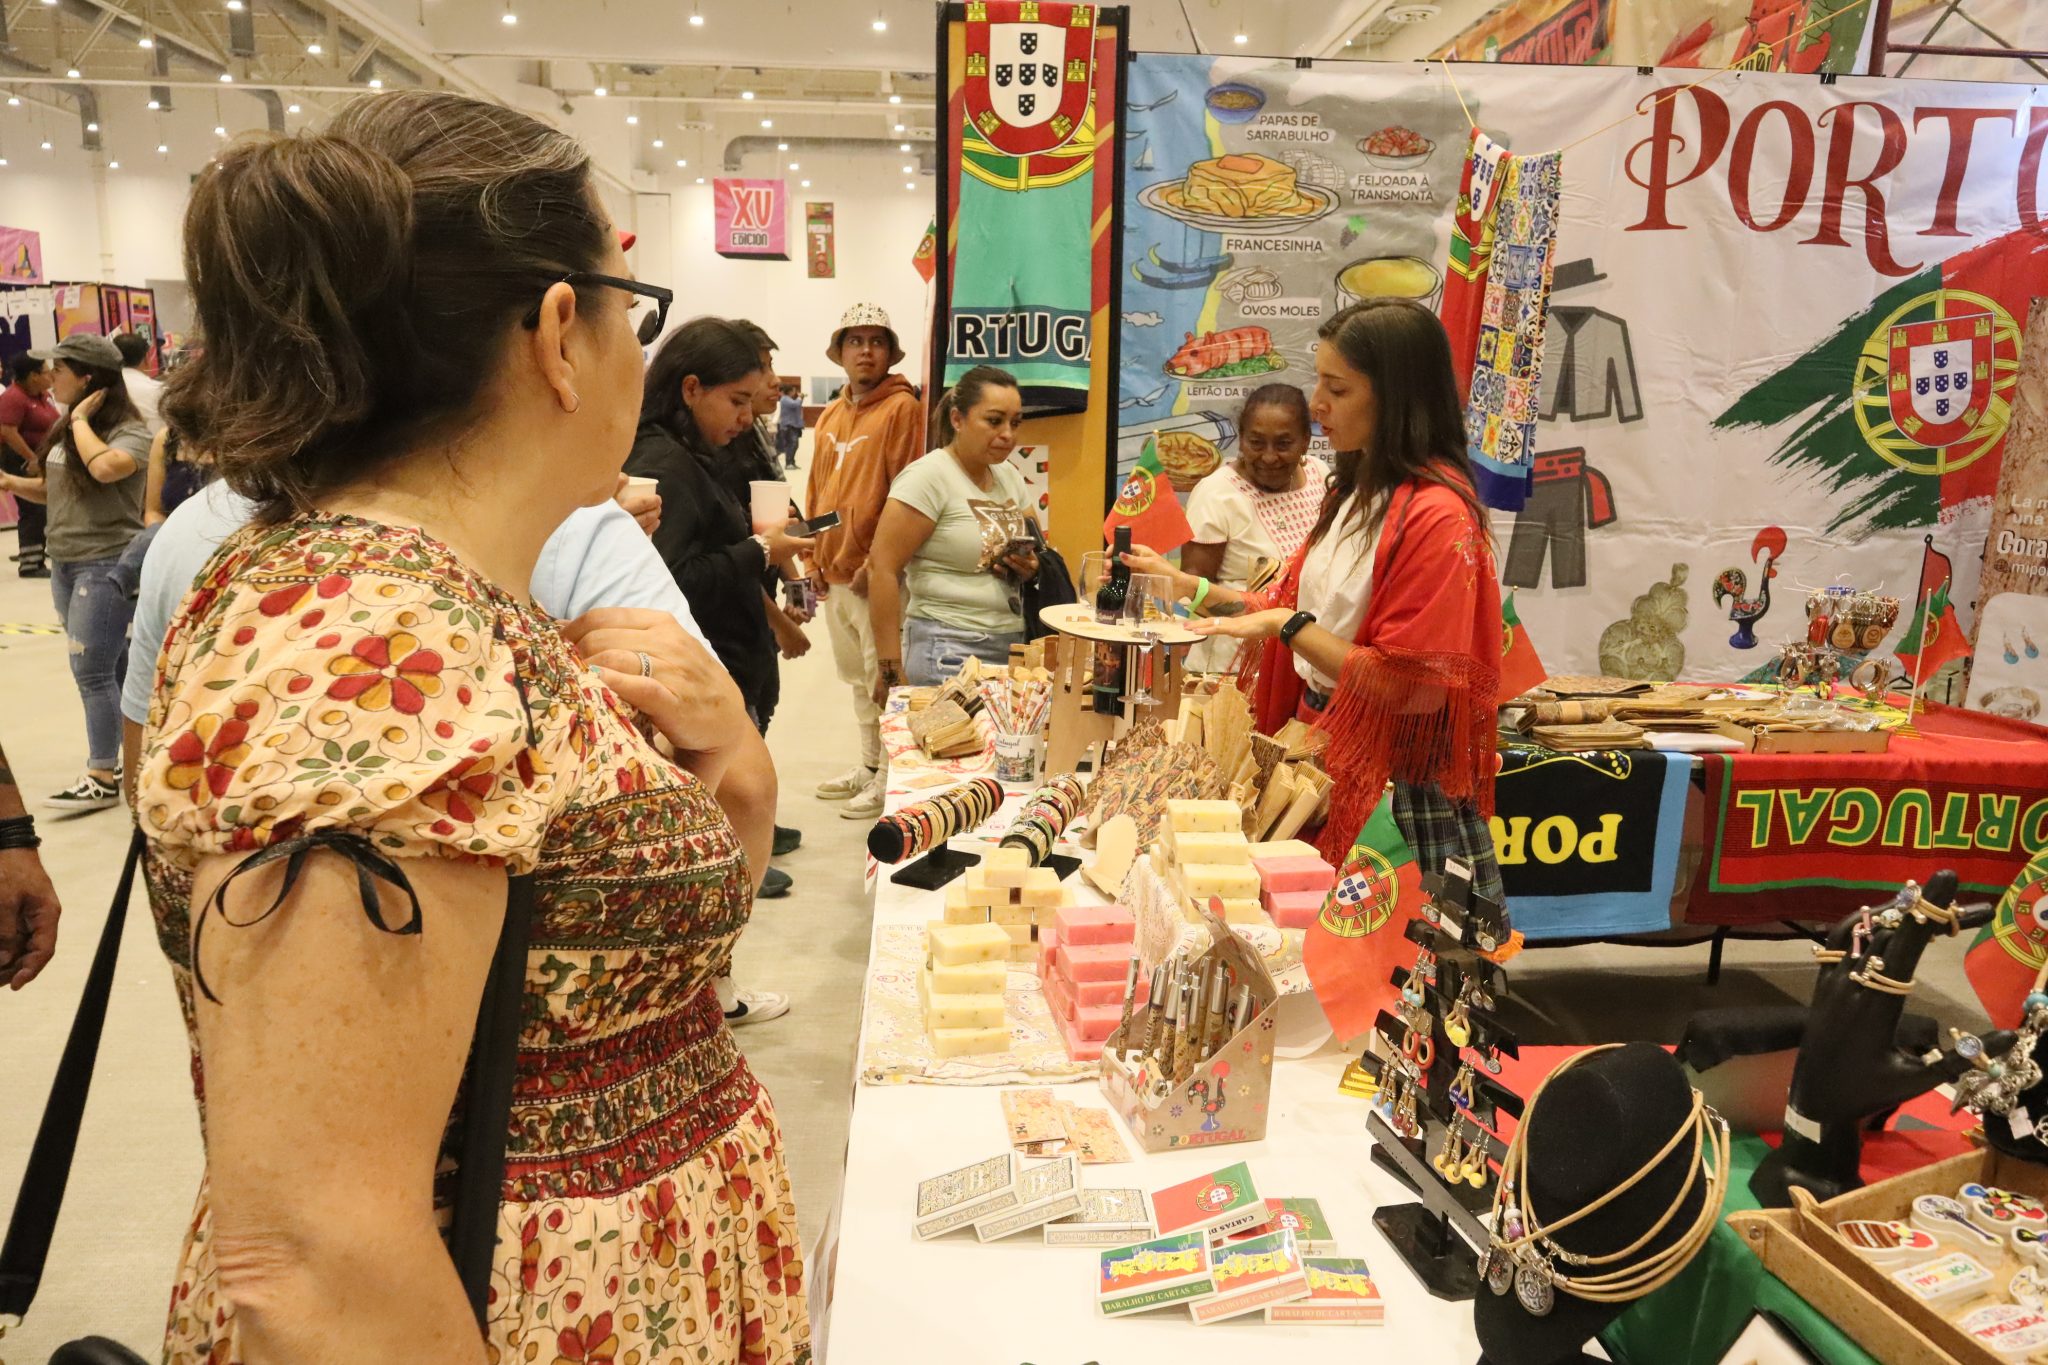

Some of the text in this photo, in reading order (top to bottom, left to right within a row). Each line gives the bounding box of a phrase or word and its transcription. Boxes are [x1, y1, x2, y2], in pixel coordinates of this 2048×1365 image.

[1259, 115, 1319, 127] PAPAS DE
[1246, 129, 1330, 143] SARRABULHO
[1357, 172, 1430, 187] FEIJOADA À
[1350, 188, 1434, 202] TRANSMONTA
[730, 187, 774, 230] XV
[1226, 238, 1323, 252] FRANCESINHA
[1241, 304, 1320, 317] OVOS MOLES
[946, 311, 1091, 362] RTUG
[1187, 385, 1222, 397] LEITÃO
[1224, 387, 1240, 397] DA
[2013, 513, 2045, 526] una
[1221, 1215, 1255, 1232] CARTAS
[1104, 1297, 1145, 1311] BARALHO
[1145, 1294, 1157, 1302] DE
[1157, 1287, 1191, 1300] CARTAS
